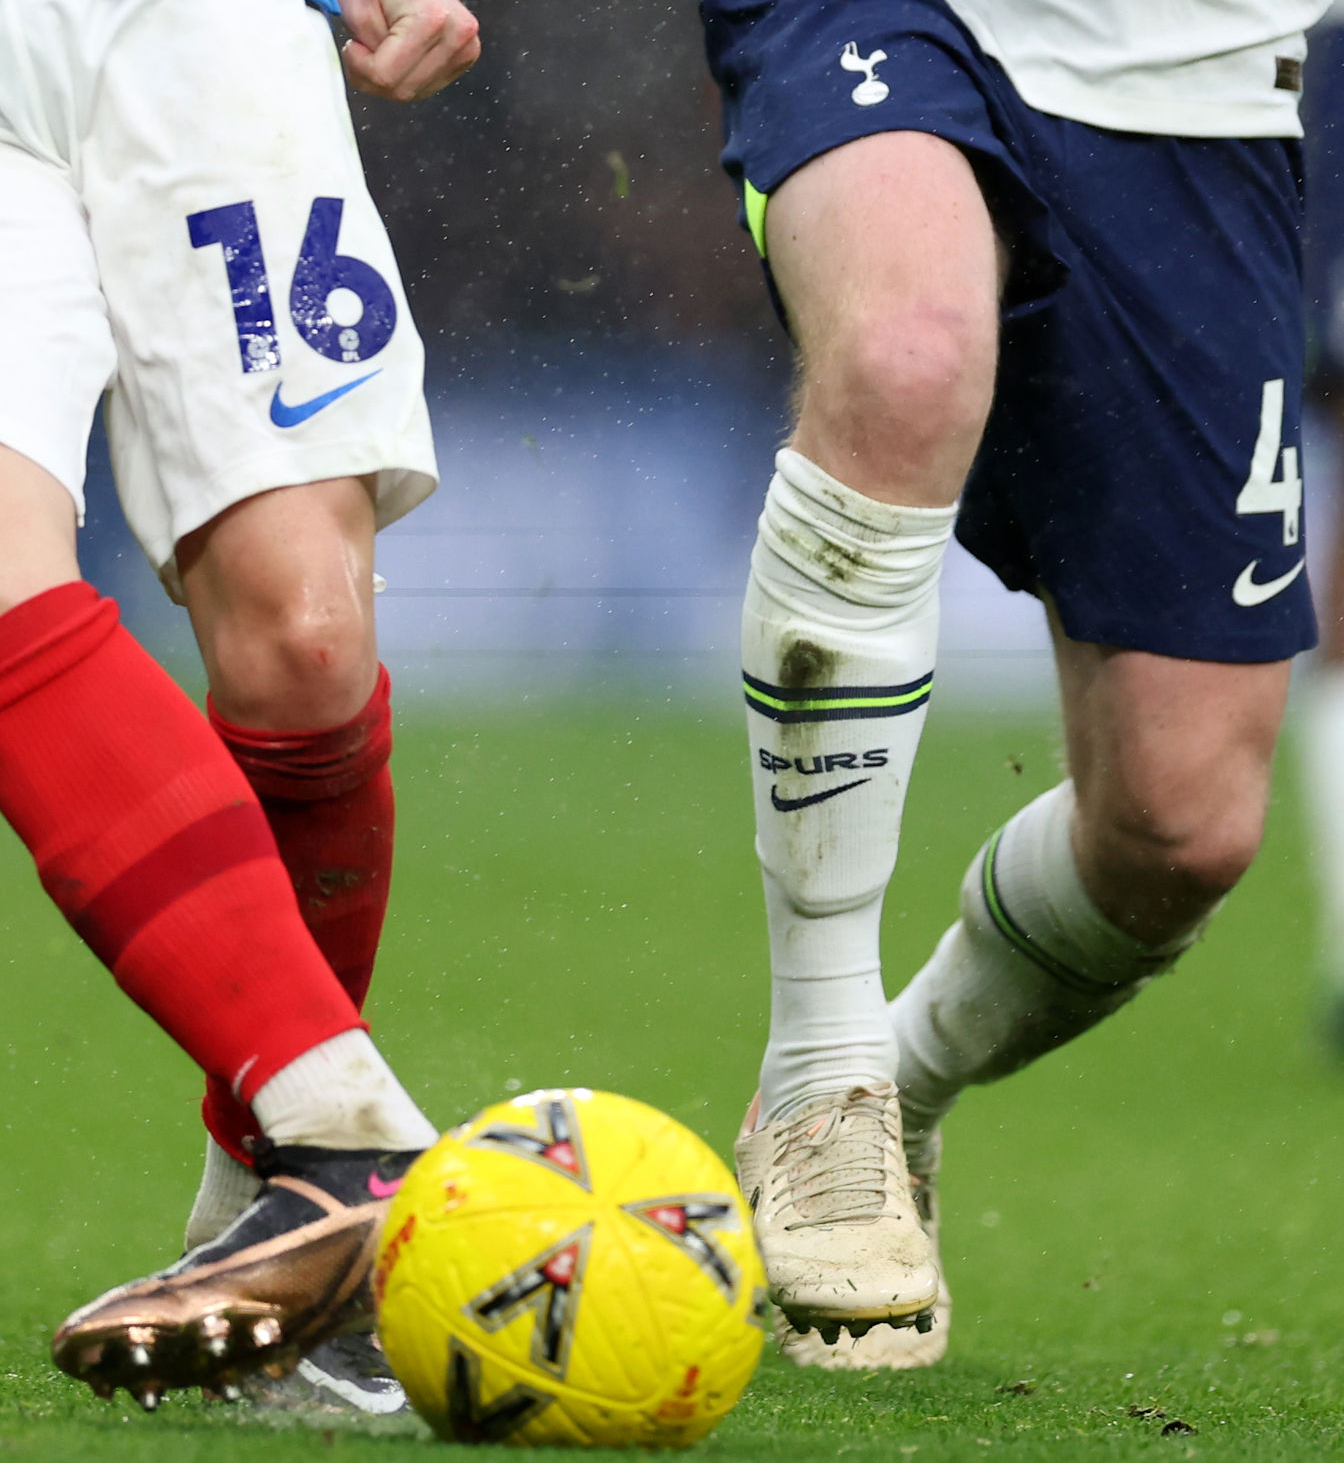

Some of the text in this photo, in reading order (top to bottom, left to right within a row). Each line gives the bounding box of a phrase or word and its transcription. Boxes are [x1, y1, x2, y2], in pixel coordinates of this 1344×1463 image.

[185, 196, 398, 374] 16
[1235, 377, 1303, 547] 4
[758, 747, 889, 776] SPURS
